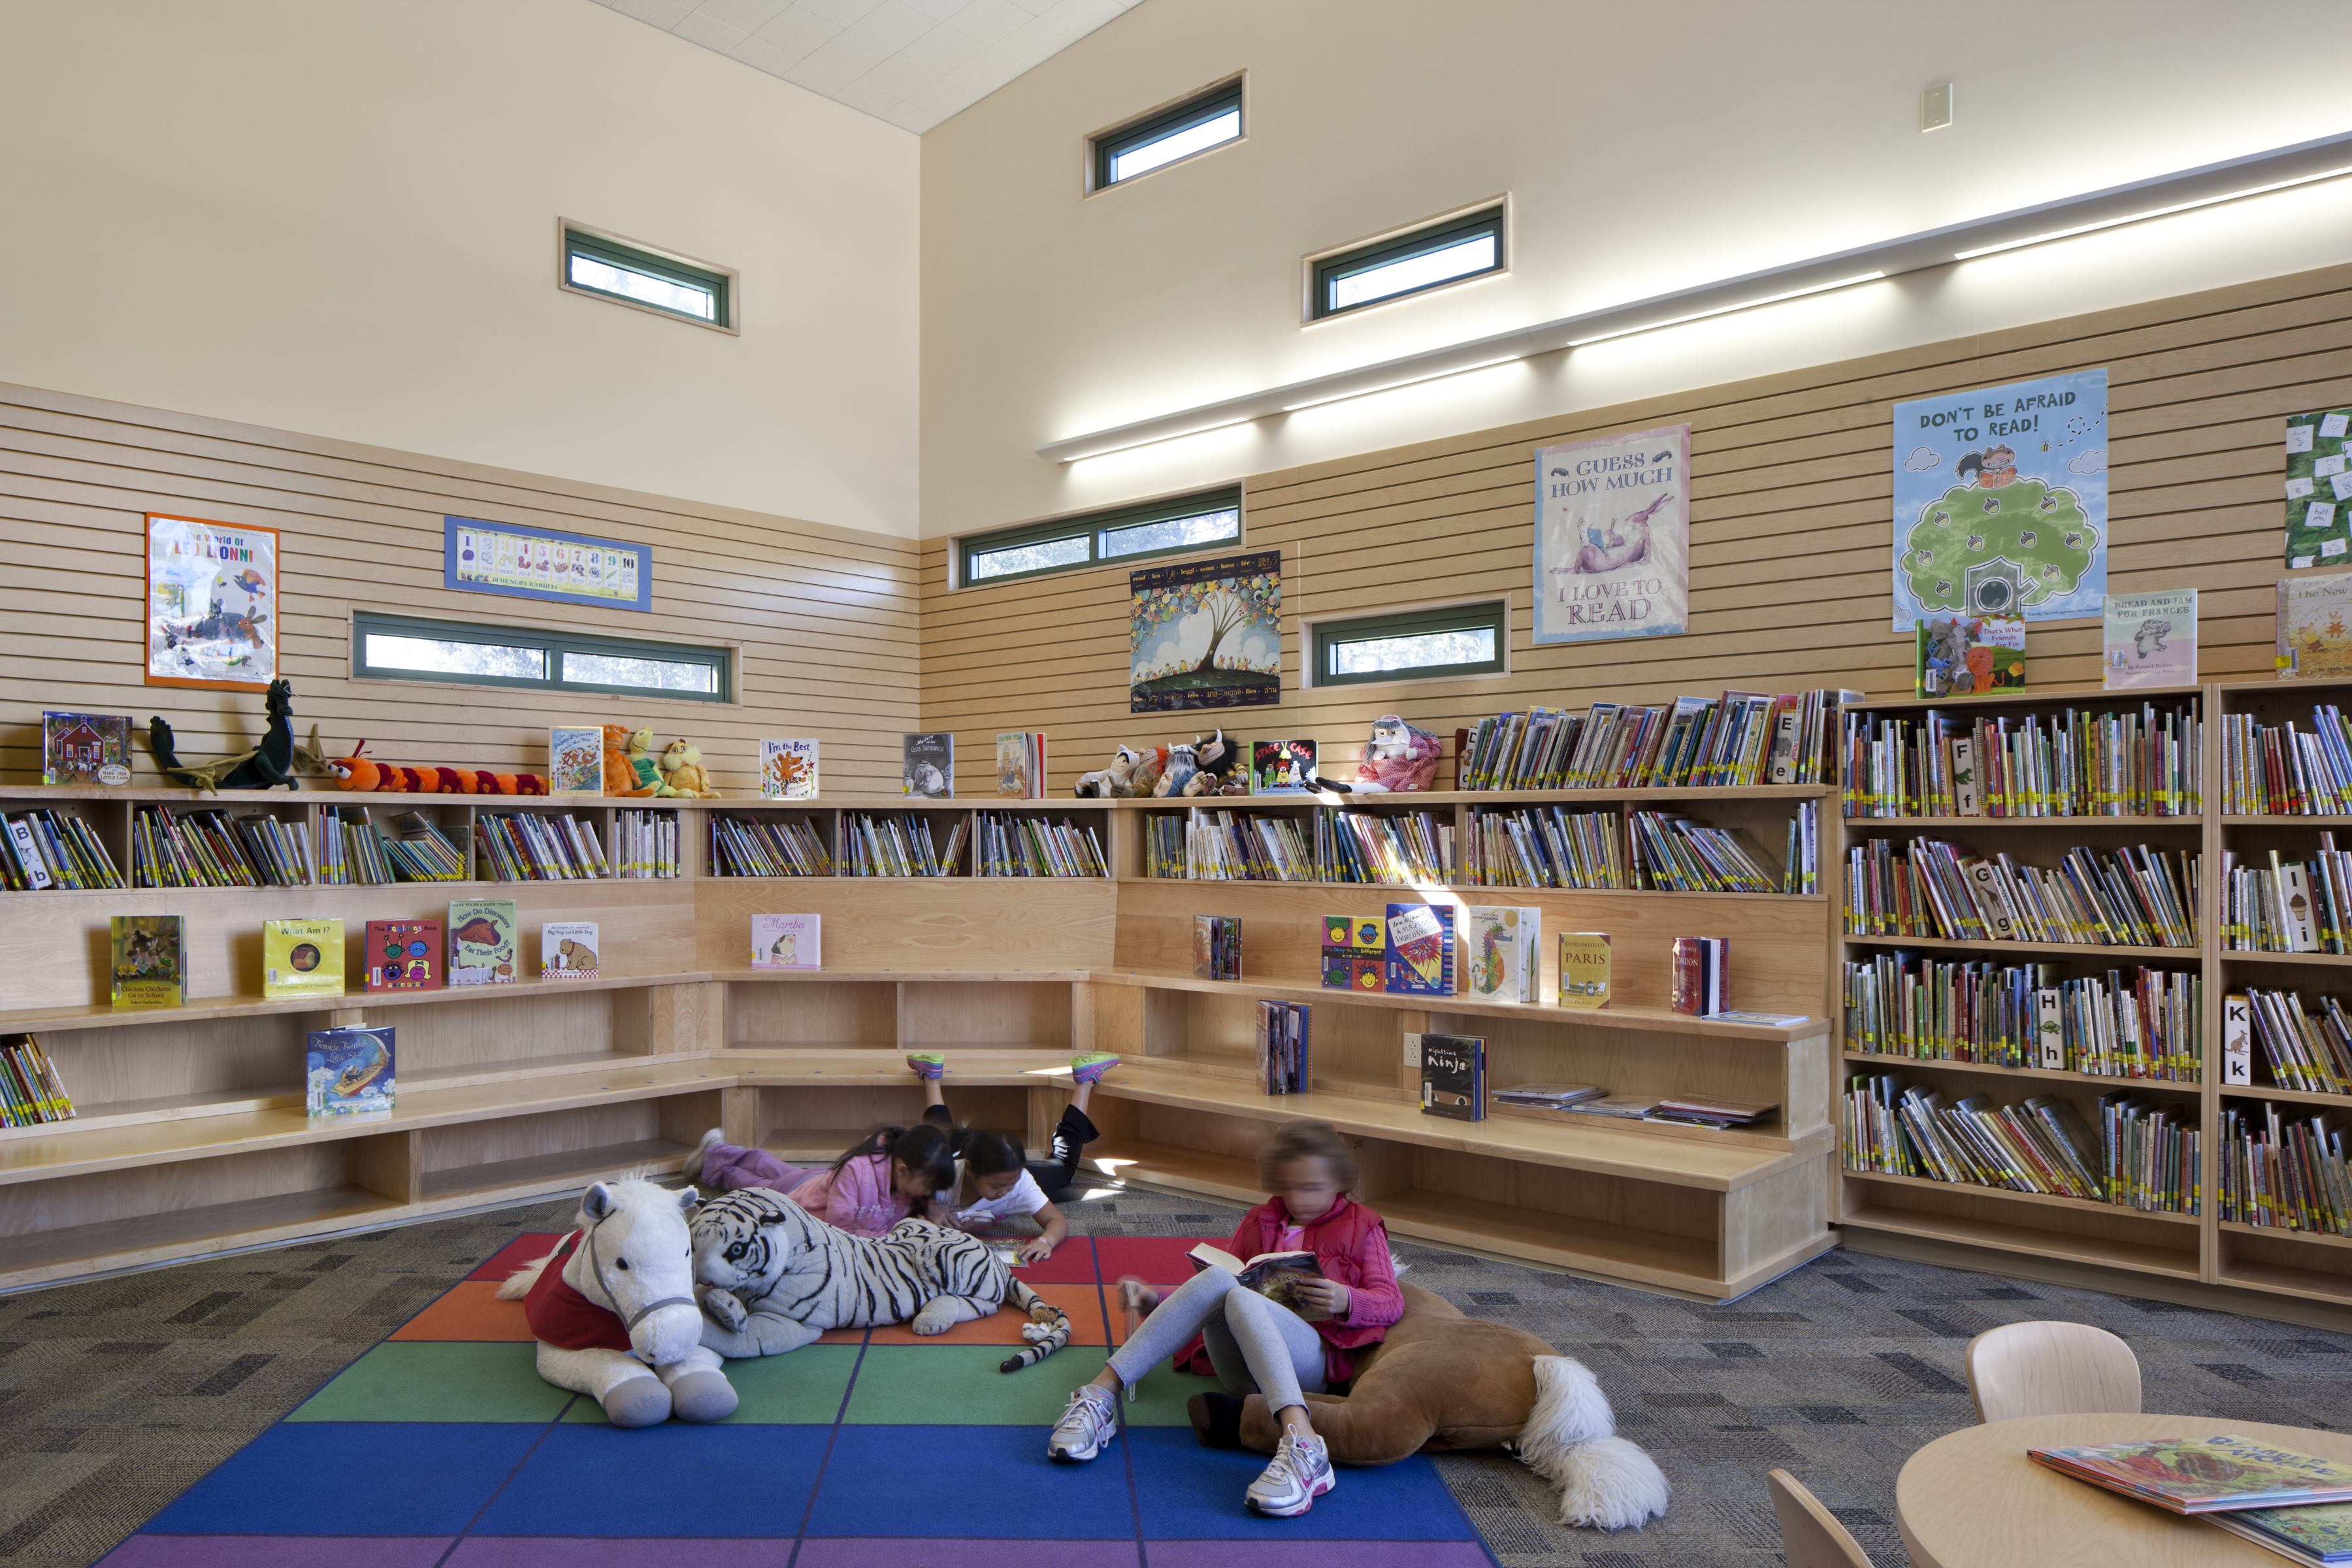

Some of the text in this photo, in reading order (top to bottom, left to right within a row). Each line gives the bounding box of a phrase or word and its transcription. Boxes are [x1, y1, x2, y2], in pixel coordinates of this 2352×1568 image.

[1920, 392, 2076, 429] DON'T BE AFRAID
[1953, 414, 2039, 442] TO READ!
[1576, 453, 1645, 476] GUESS
[1550, 466, 1673, 498] HOW MUCH
[204, 534, 231, 544] World
[465, 536, 470, 546] 1
[482, 537, 491, 549] 2
[174, 541, 253, 563] LEO LIONNI
[502, 540, 509, 552] 3
[520, 544, 529, 555] 4
[539, 546, 547, 557] 5
[556, 548, 564, 559] 6
[574, 550, 582, 561] 7
[591, 553, 599, 564] 8
[608, 555, 616, 566] 9
[622, 558, 634, 569] 10
[1258, 555, 1277, 568] 読もう
[529, 581, 558, 590] RABBITS
[1558, 578, 1662, 602] I LOVE TO
[2296, 587, 2347, 598] The New
[2114, 596, 2193, 609] BREAD AND JAM
[1566, 598, 1651, 626] READ
[2142, 606, 2189, 617] FRANCES
[1264, 685, 1277, 694] อ่าน
[1782, 717, 1792, 730] E
[553, 738, 570, 749] Paper
[916, 735, 934, 745] Mystery
[769, 742, 781, 754] I'm
[794, 742, 810, 752] Best
[1255, 742, 1313, 762] SPACE CASE
[1957, 745, 1968, 759] F
[1776, 767, 1786, 777] e
[1963, 794, 1971, 808] f
[15, 826, 29, 841] B
[33, 870, 46, 882] b
[1976, 868, 1991, 882] G
[2291, 872, 2298, 887] I
[457, 911, 472, 923] How
[484, 907, 510, 929] Dinosaurs
[762, 915, 806, 929] Martha
[1997, 917, 2010, 932] g
[387, 924, 422, 934] Feelings
[1397, 919, 1431, 936] AMAZING
[2301, 926, 2308, 943] i
[465, 944, 474, 954] Eat
[493, 939, 510, 954] Food?
[1565, 953, 1605, 965] PARIS
[2042, 995, 2055, 1009] H
[2229, 1006, 2247, 1022] K
[310, 1037, 341, 1051] Twinkle,
[326, 1049, 365, 1063] Little Star
[1428, 1047, 1457, 1056] Nighttime
[2046, 1046, 2057, 1060] h
[2232, 1060, 2246, 1077] k
[1970, 1150, 1979, 1158] Full
